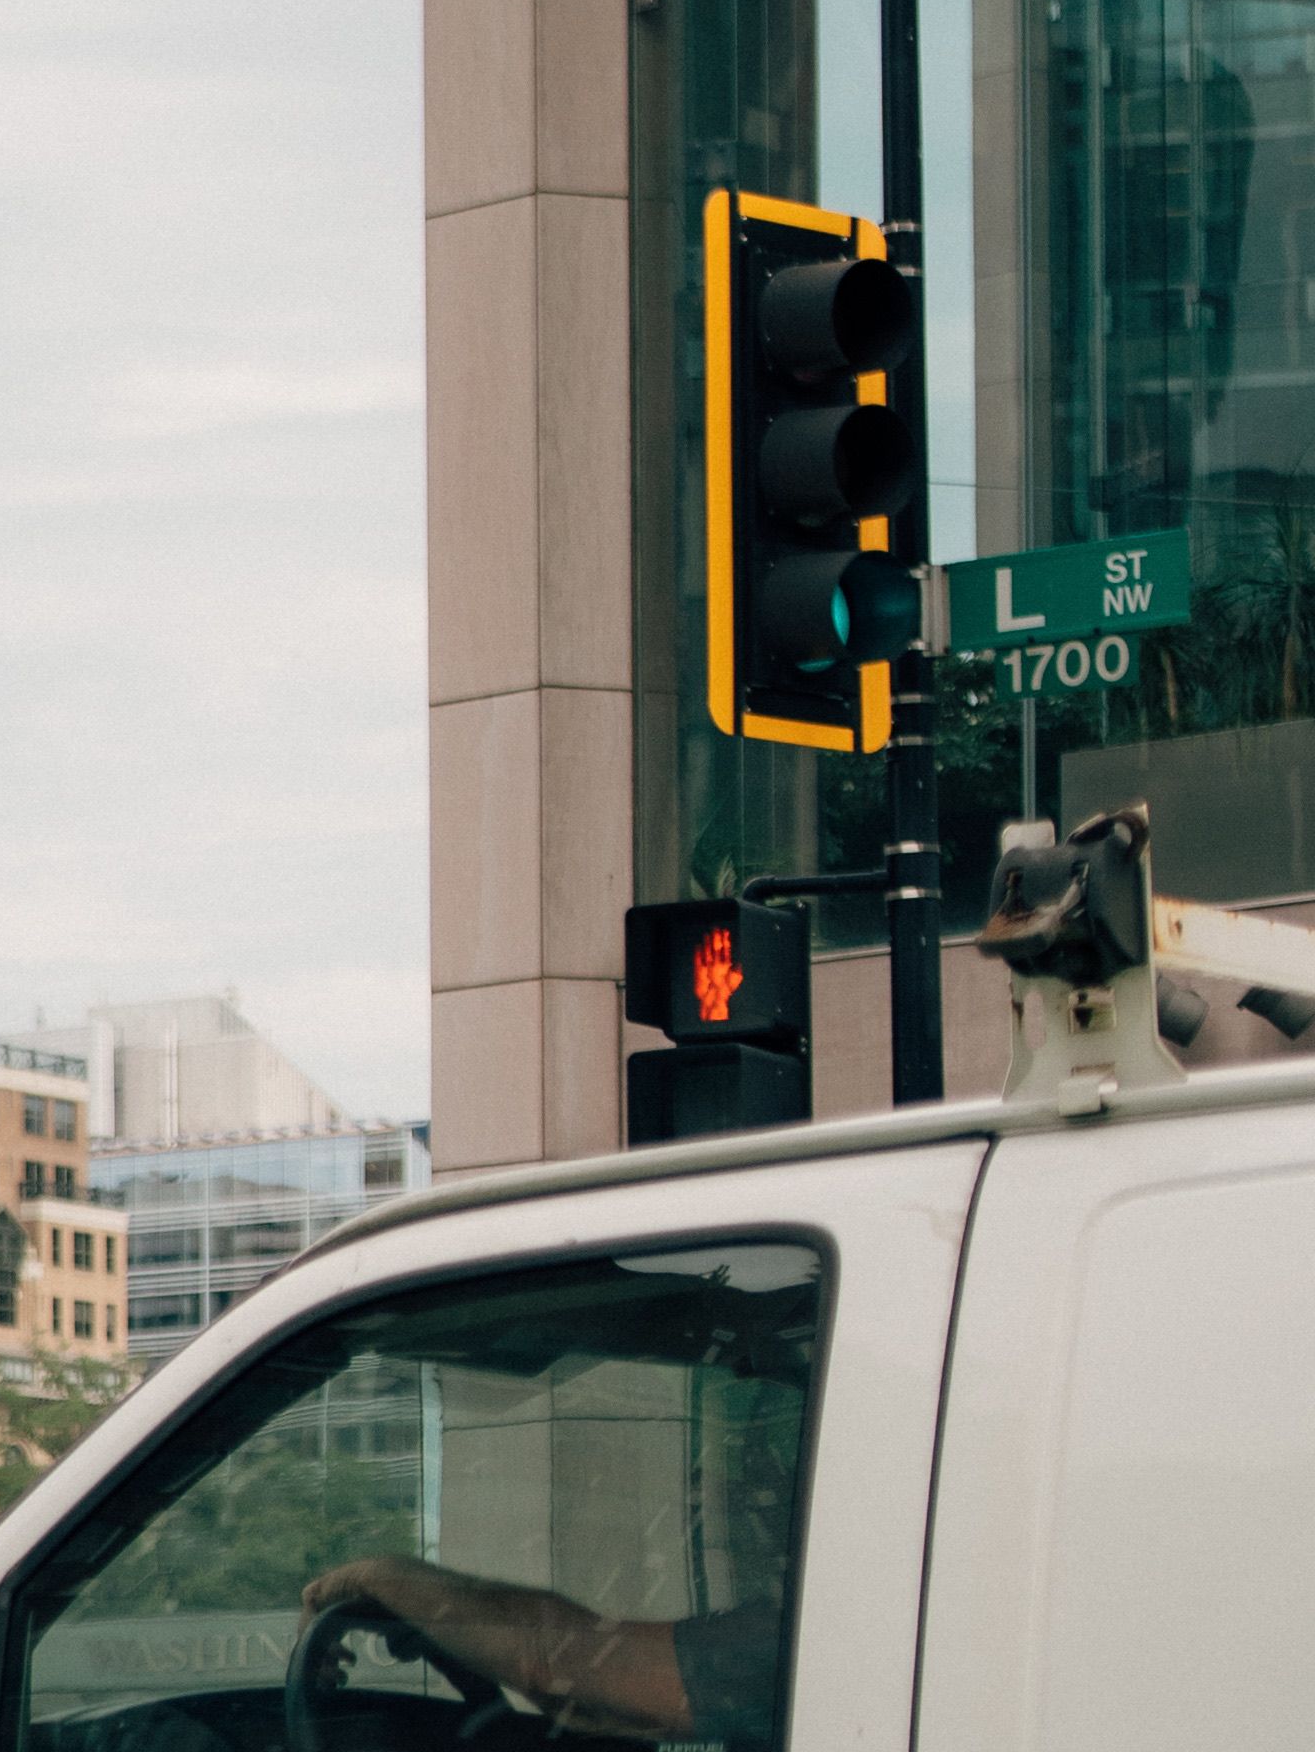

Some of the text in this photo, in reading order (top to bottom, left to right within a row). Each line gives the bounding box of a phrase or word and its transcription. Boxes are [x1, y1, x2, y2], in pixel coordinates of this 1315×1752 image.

[1104, 549, 1148, 584] ST
[995, 566, 1046, 633] L
[1102, 581, 1154, 617] NW
[1002, 634, 1130, 694] 1700
